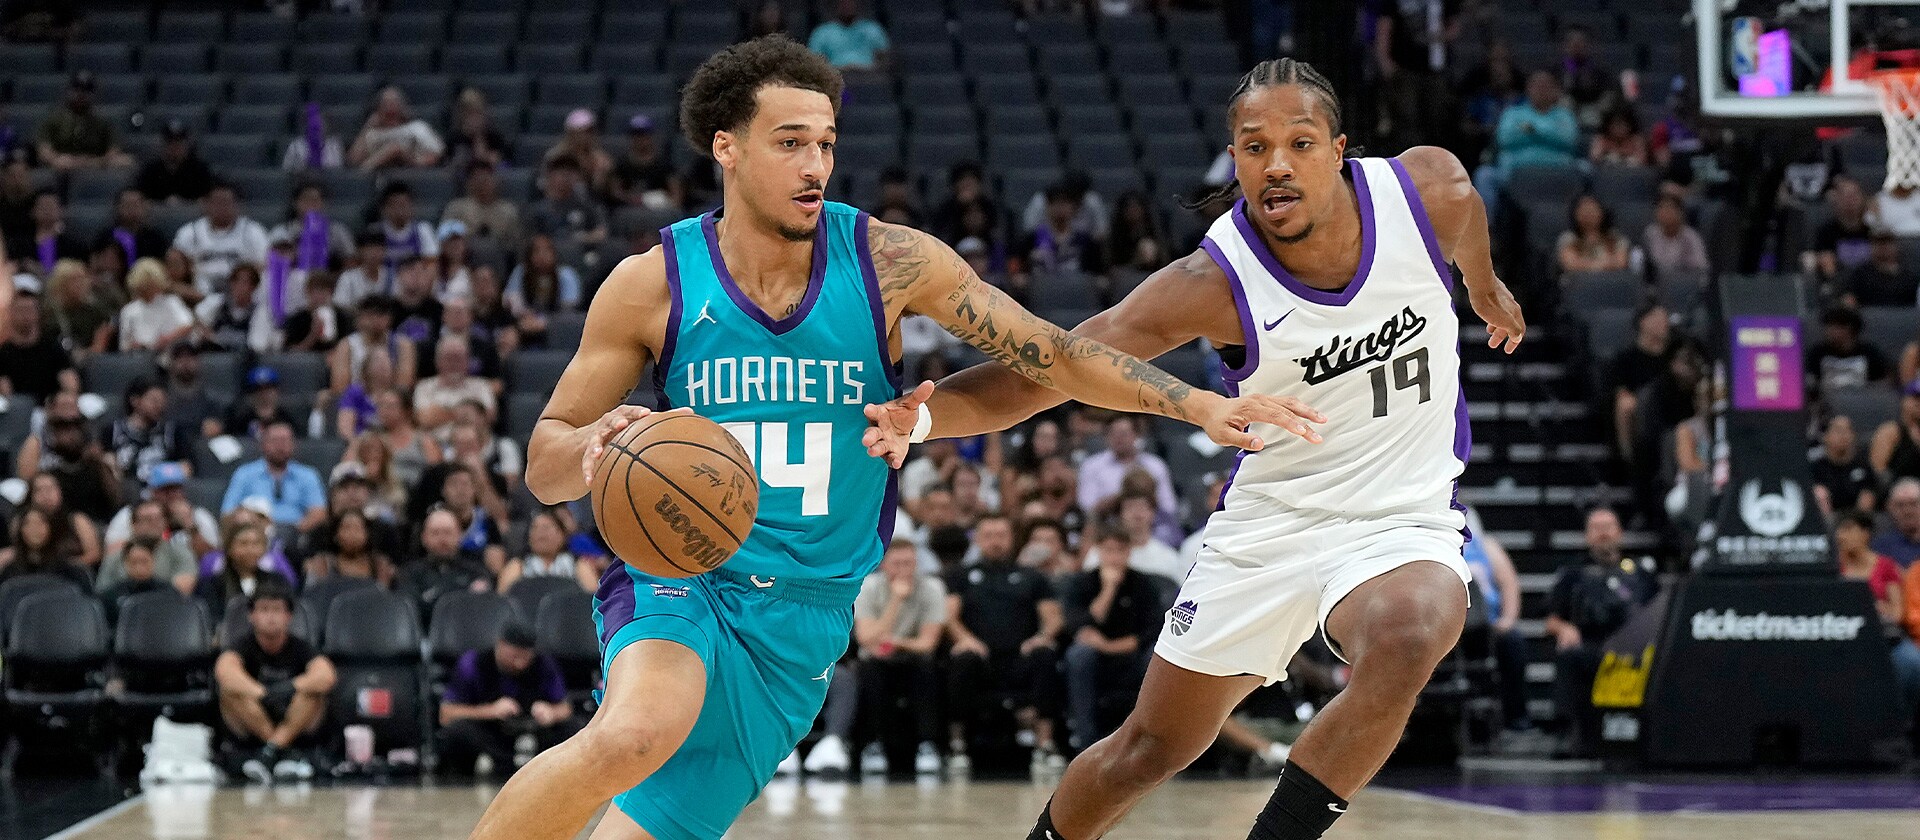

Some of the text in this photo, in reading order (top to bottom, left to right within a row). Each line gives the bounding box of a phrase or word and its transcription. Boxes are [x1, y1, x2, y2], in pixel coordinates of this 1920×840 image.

[1293, 305, 1427, 386] Kings
[685, 356, 866, 407] HORNETS
[1366, 347, 1432, 418] 19
[654, 493, 731, 569] Wilson
[654, 589, 688, 597] HORNETS
[1171, 608, 1194, 625] KINGS
[1691, 608, 1865, 641] ticketmaster
